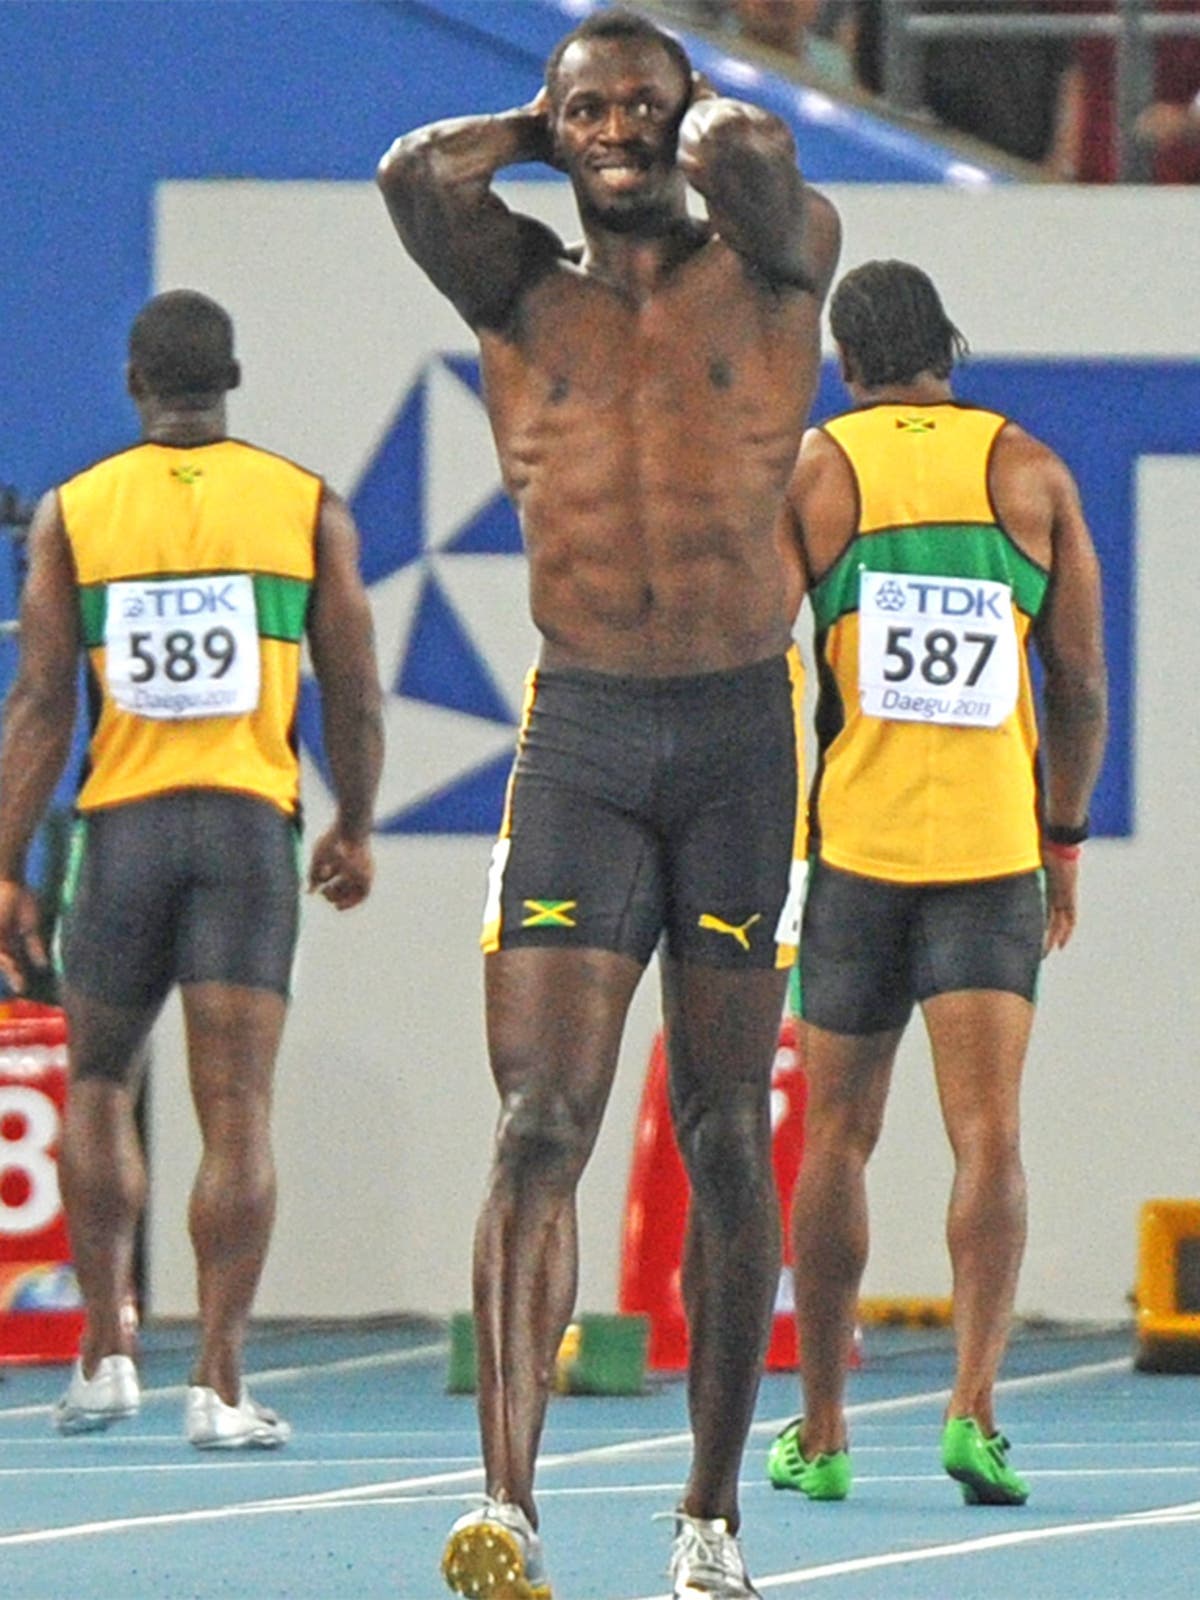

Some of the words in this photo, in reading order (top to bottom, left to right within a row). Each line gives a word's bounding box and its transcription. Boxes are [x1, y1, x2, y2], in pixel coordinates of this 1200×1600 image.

[144, 583, 236, 617] TDK
[907, 582, 1003, 619] TDK
[129, 625, 237, 683] 589
[883, 626, 998, 687] 587
[881, 690, 951, 718] Daegu
[952, 699, 991, 717] 2011
